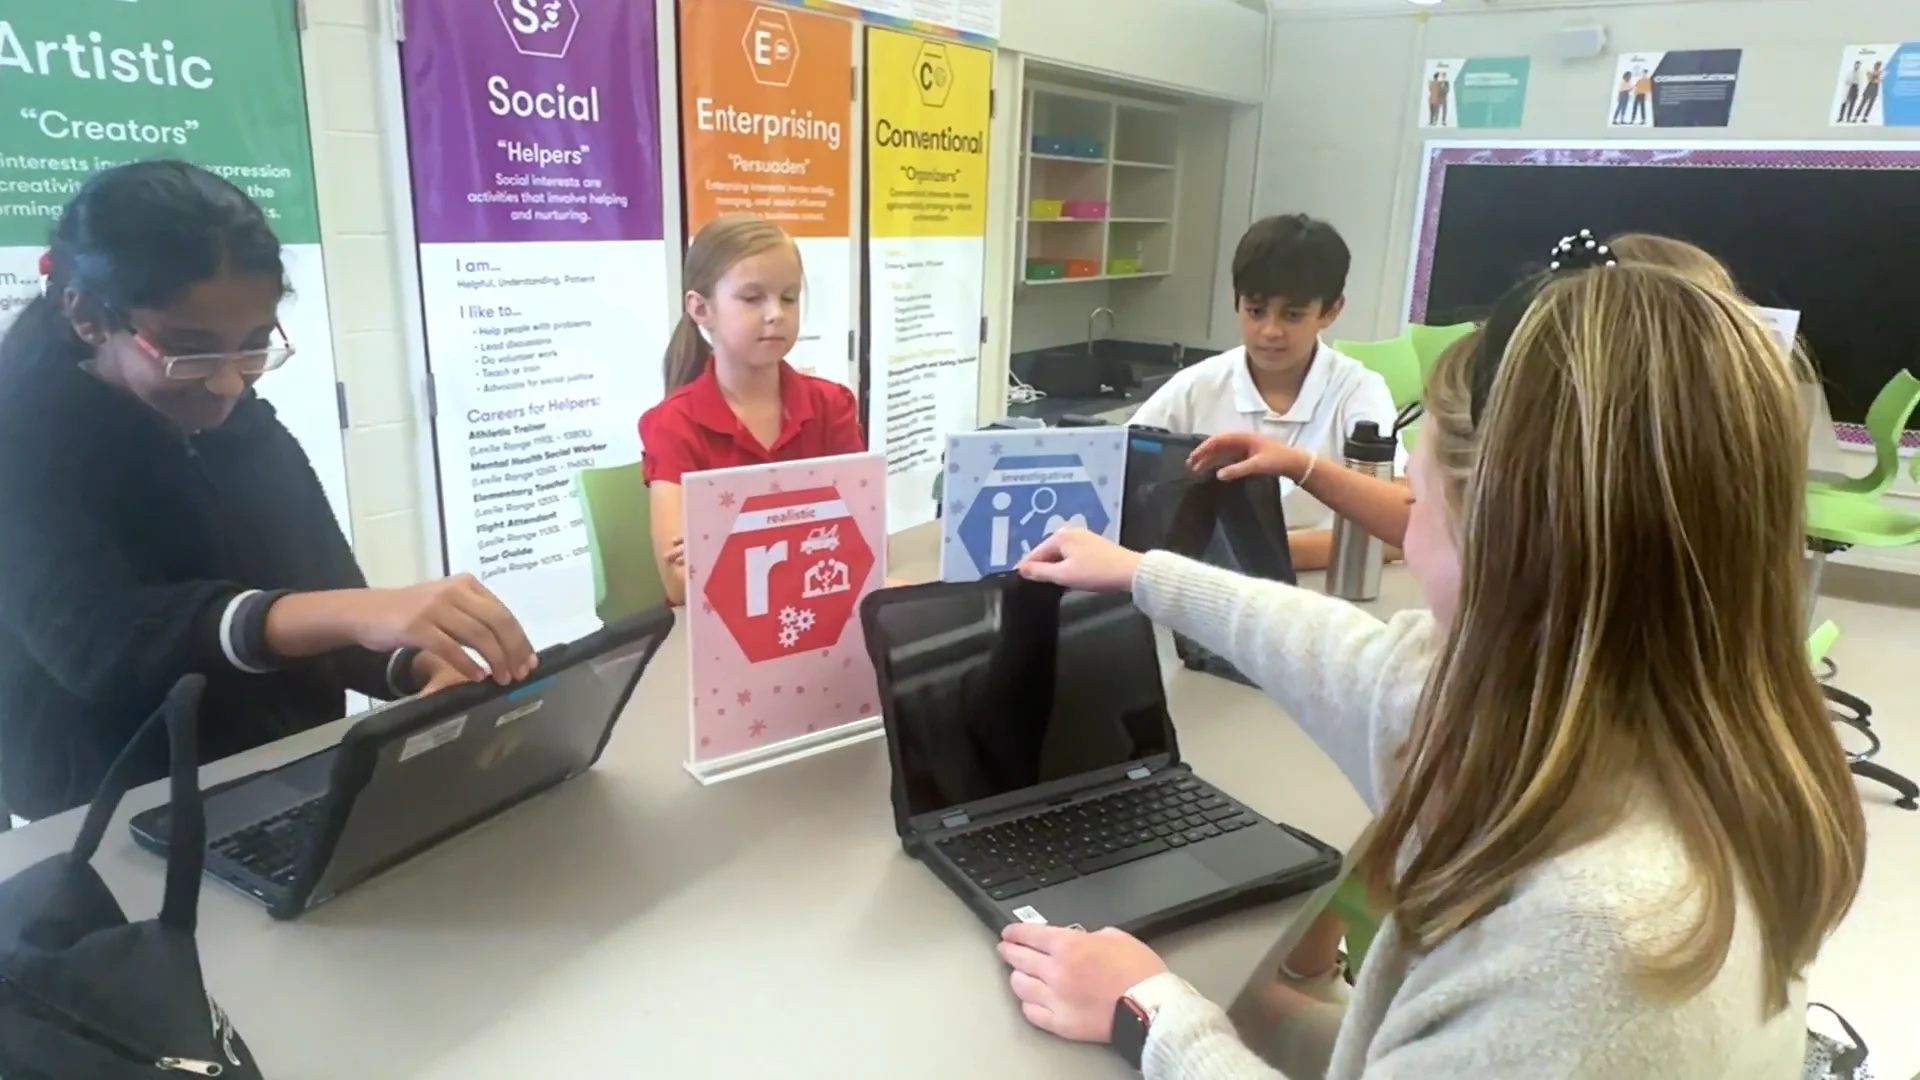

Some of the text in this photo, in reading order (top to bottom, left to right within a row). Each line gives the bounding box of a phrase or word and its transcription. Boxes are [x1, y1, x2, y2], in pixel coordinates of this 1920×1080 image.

[0, 20, 214, 89] Artistic
[755, 30, 772, 65] E
[920, 62, 933, 91] C
[487, 75, 599, 122] Social
[20, 107, 199, 145] “Creators”
[696, 97, 840, 150] Enterprising
[876, 119, 983, 155] Conventional
[0, 152, 89, 171] interests
[497, 140, 590, 168] “Helpers”
[0, 178, 275, 198] creativit the
[495, 173, 602, 188] Social interests are
[467, 191, 628, 208] activities that involve helping
[510, 208, 591, 223] and nurturing.
[456, 258, 460, 272] I
[460, 305, 464, 318] I
[469, 305, 494, 319] like
[504, 325, 530, 335] people
[467, 397, 601, 424] Careers for Helpers:
[471, 443, 607, 472] Mental Health Social Worker
[1001, 471, 1074, 484] investigative
[473, 479, 570, 503] Elementary Teacher
[476, 520, 505, 534] Flight
[507, 511, 558, 527] Attendant
[766, 508, 816, 524] realistic
[990, 492, 1012, 567] i
[479, 553, 500, 564] Tour
[745, 540, 788, 618] r
